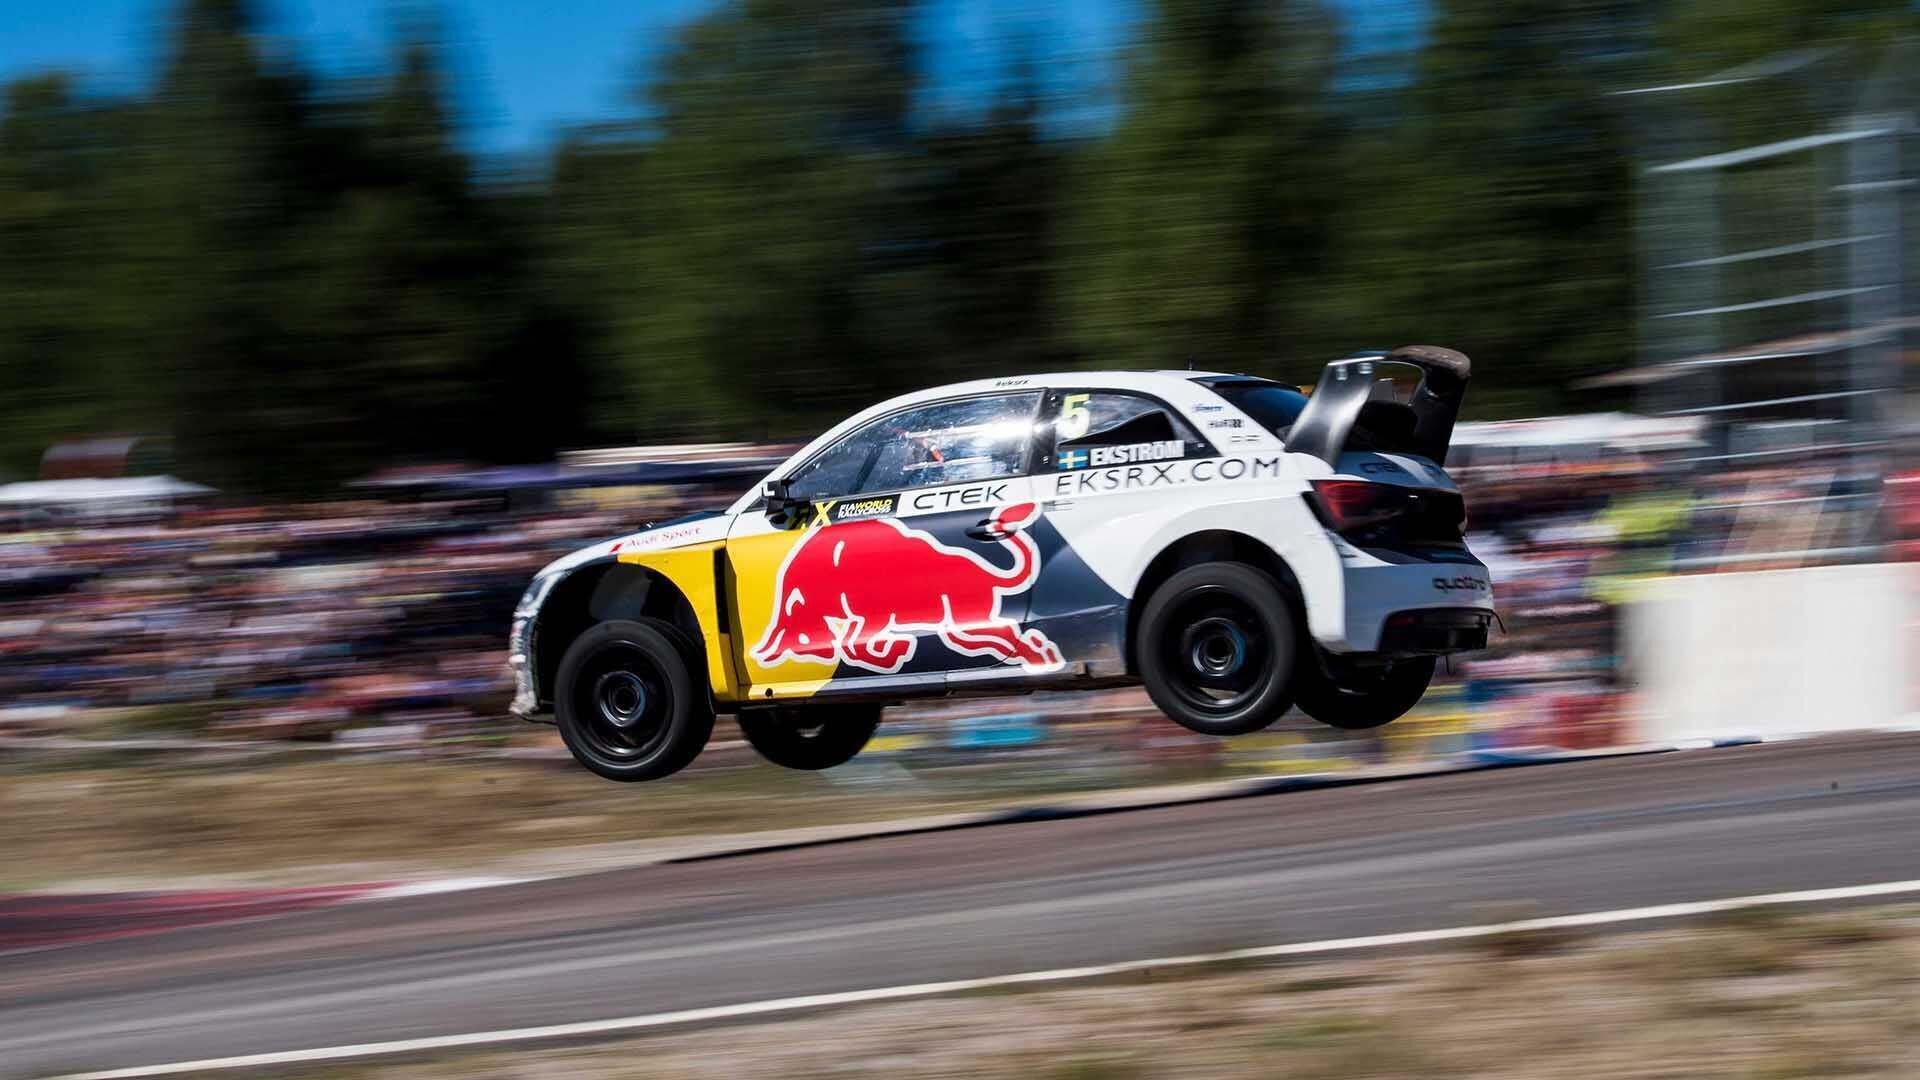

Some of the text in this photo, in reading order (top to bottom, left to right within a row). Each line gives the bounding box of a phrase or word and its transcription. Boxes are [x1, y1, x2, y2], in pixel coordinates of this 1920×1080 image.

[1060, 393, 1090, 438] 5
[1091, 440, 1184, 466] EKSTRÖM
[1056, 457, 1279, 495] EKSRX.COM
[913, 484, 1007, 510] CTEK
